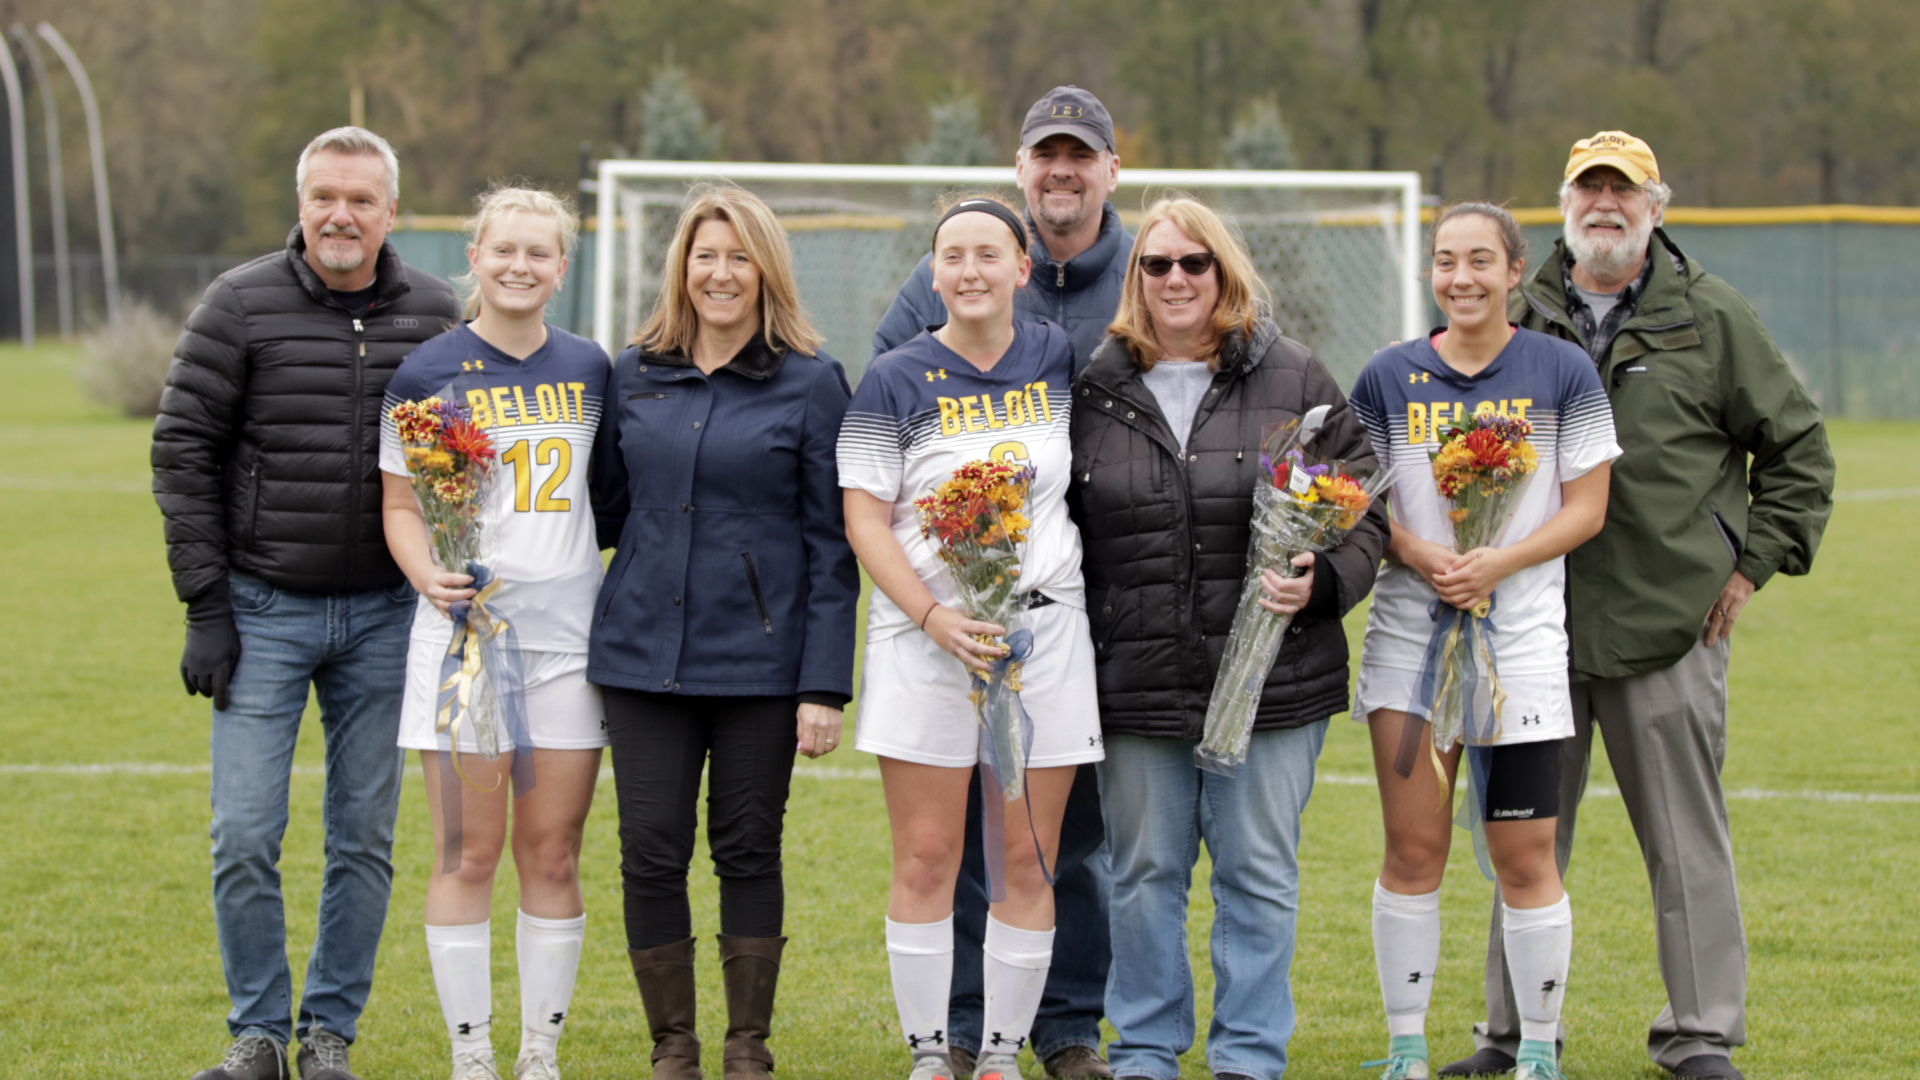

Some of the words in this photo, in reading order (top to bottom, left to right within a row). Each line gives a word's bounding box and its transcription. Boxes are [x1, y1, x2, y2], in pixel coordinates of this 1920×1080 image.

[465, 382, 586, 429] BELOIT
[936, 381, 1052, 437] BELOIT
[1407, 398, 1533, 445] BET
[501, 437, 572, 512] 12
